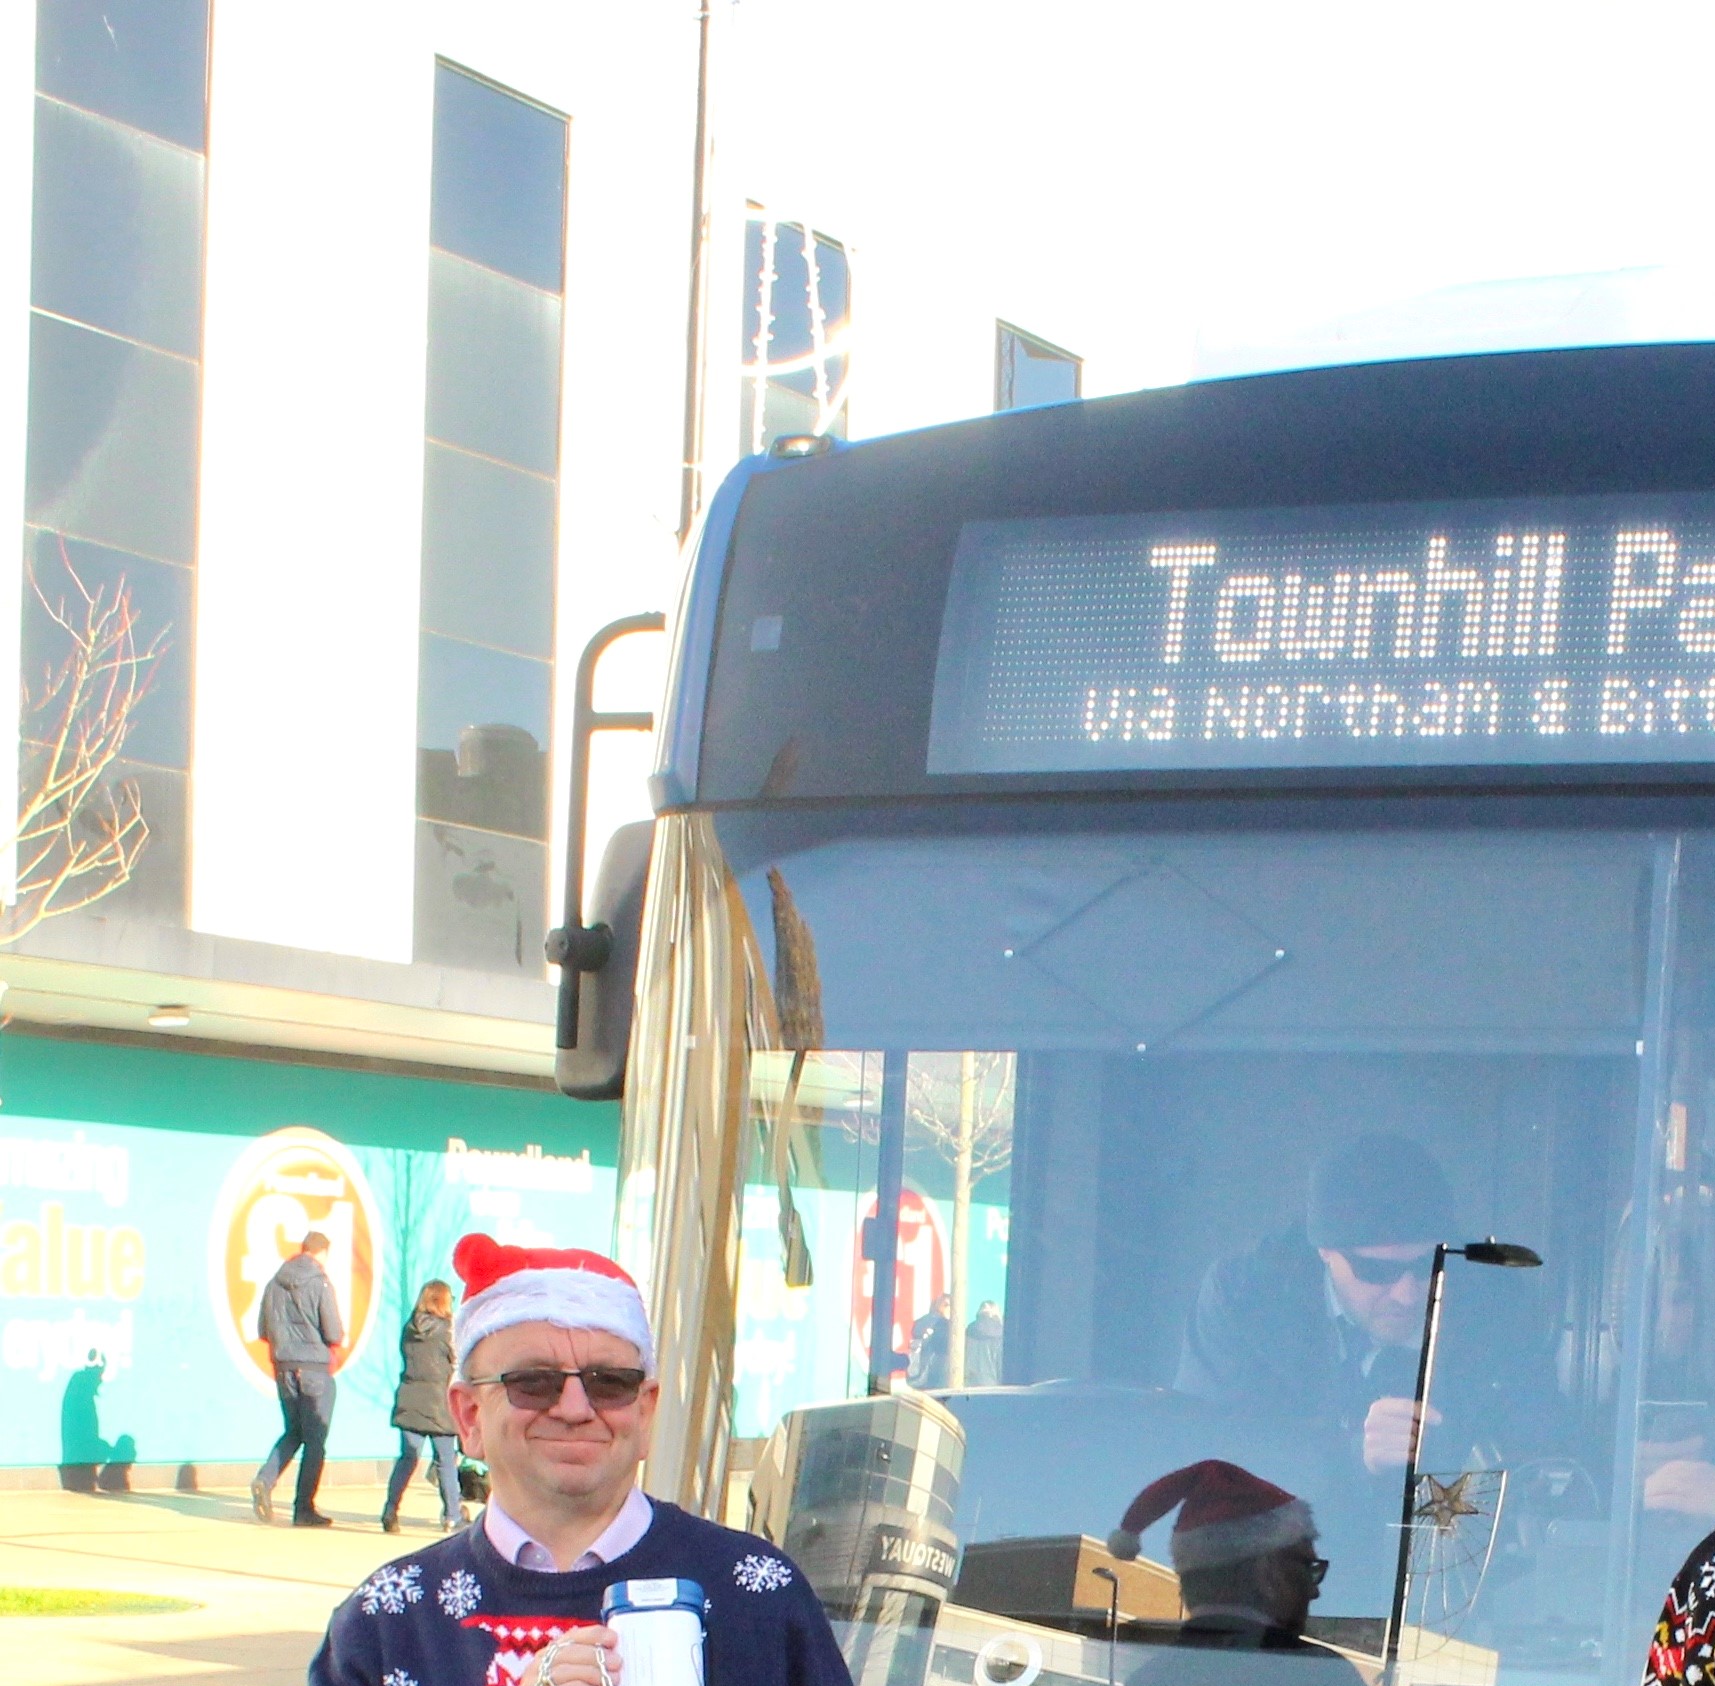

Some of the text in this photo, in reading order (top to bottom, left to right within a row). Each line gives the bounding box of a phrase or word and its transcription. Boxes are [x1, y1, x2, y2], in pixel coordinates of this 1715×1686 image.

[1150, 533, 1567, 664] Townhill
[1202, 678, 1503, 742] Northam
[1530, 680, 1571, 738] &
[0, 1200, 147, 1301] alue
